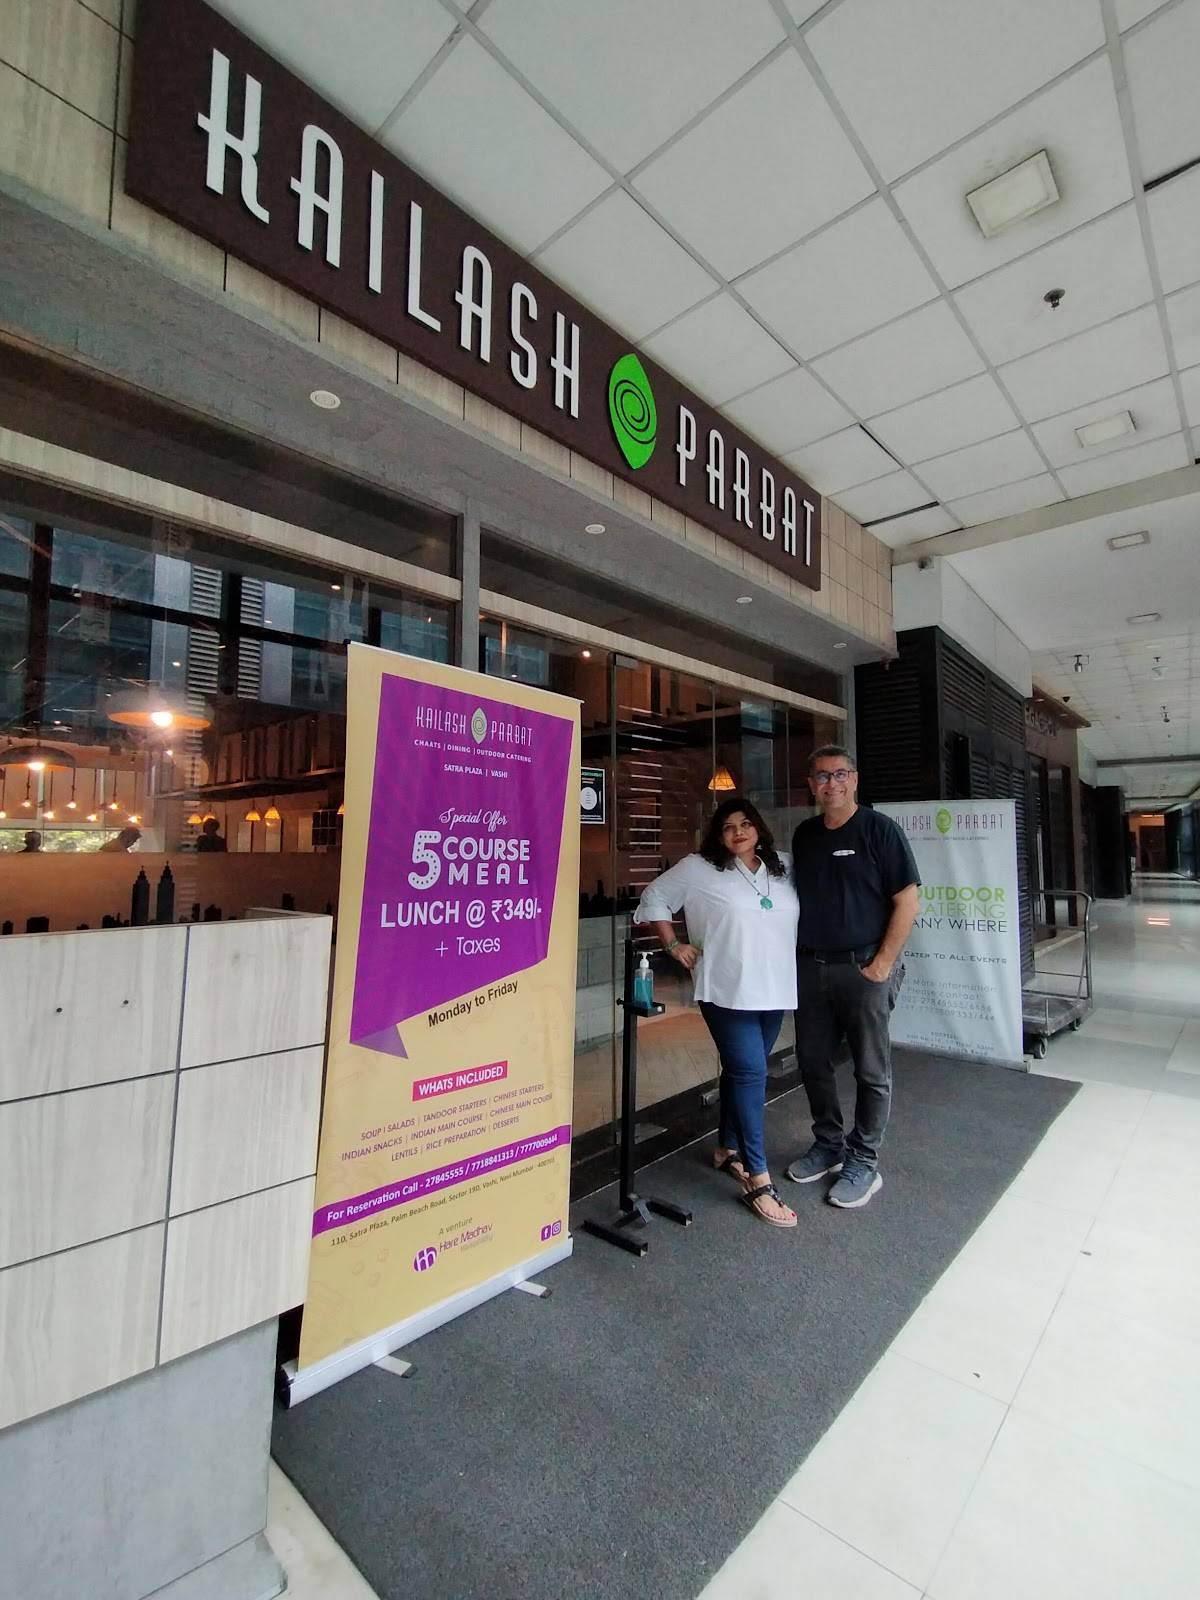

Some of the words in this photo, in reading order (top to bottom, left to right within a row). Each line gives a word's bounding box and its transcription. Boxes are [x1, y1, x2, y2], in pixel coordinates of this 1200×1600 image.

[197, 47, 580, 419] KAILASH
[676, 404, 815, 567] PARBAT
[416, 706, 467, 734] KAILASH
[491, 721, 532, 746] PARBAT
[414, 739, 441, 749] CHAATS
[447, 743, 471, 753] DINING
[476, 749, 505, 759] OUTDOOR
[506, 753, 532, 763] CATERING
[444, 763, 463, 773] SATRA
[465, 766, 483, 775] PLAZA
[491, 770, 508, 778] VASHI
[439, 808, 480, 830] Special
[482, 811, 508, 832] Offer
[957, 814, 1004, 830] PARBAT
[407, 830, 442, 890] 5
[442, 836, 530, 861] COURSE
[448, 862, 529, 885] MEAL
[381, 900, 460, 928] LUNCH
[466, 900, 486, 928] @
[922, 902, 1006, 919] ATERING
[948, 918, 1008, 933] WHERE
[456, 936, 501, 956] Taxes
[428, 1001, 473, 1027] Monday
[475, 995, 486, 1007] to
[487, 980, 519, 1001] Friday
[418, 1078, 453, 1096] WHATS
[456, 1065, 504, 1087] INCLUDED
[361, 1128, 382, 1141] SOUP
[387, 1118, 415, 1133] SALADS
[459, 1098, 487, 1113] STARTERS
[493, 1092, 518, 1103] CHINESE
[519, 1083, 545, 1095] STARTERS
[341, 1146, 371, 1161] INDIAN
[373, 1137, 402, 1152] SNACKS
[411, 1127, 436, 1141] INDIAN
[437, 1121, 456, 1133] MAIN
[457, 1113, 483, 1127] COURSE
[490, 1104, 514, 1117] CHINESE
[516, 1098, 532, 1109] MAIN
[391, 1147, 418, 1161] LENTILS
[426, 1139, 442, 1150] RICE
[444, 1126, 487, 1143] PREPARATION
[493, 1116, 520, 1130] DESSERTS
[327, 1209, 345, 1222] For
[346, 1189, 401, 1216] Reservation
[402, 1181, 418, 1196] Call
